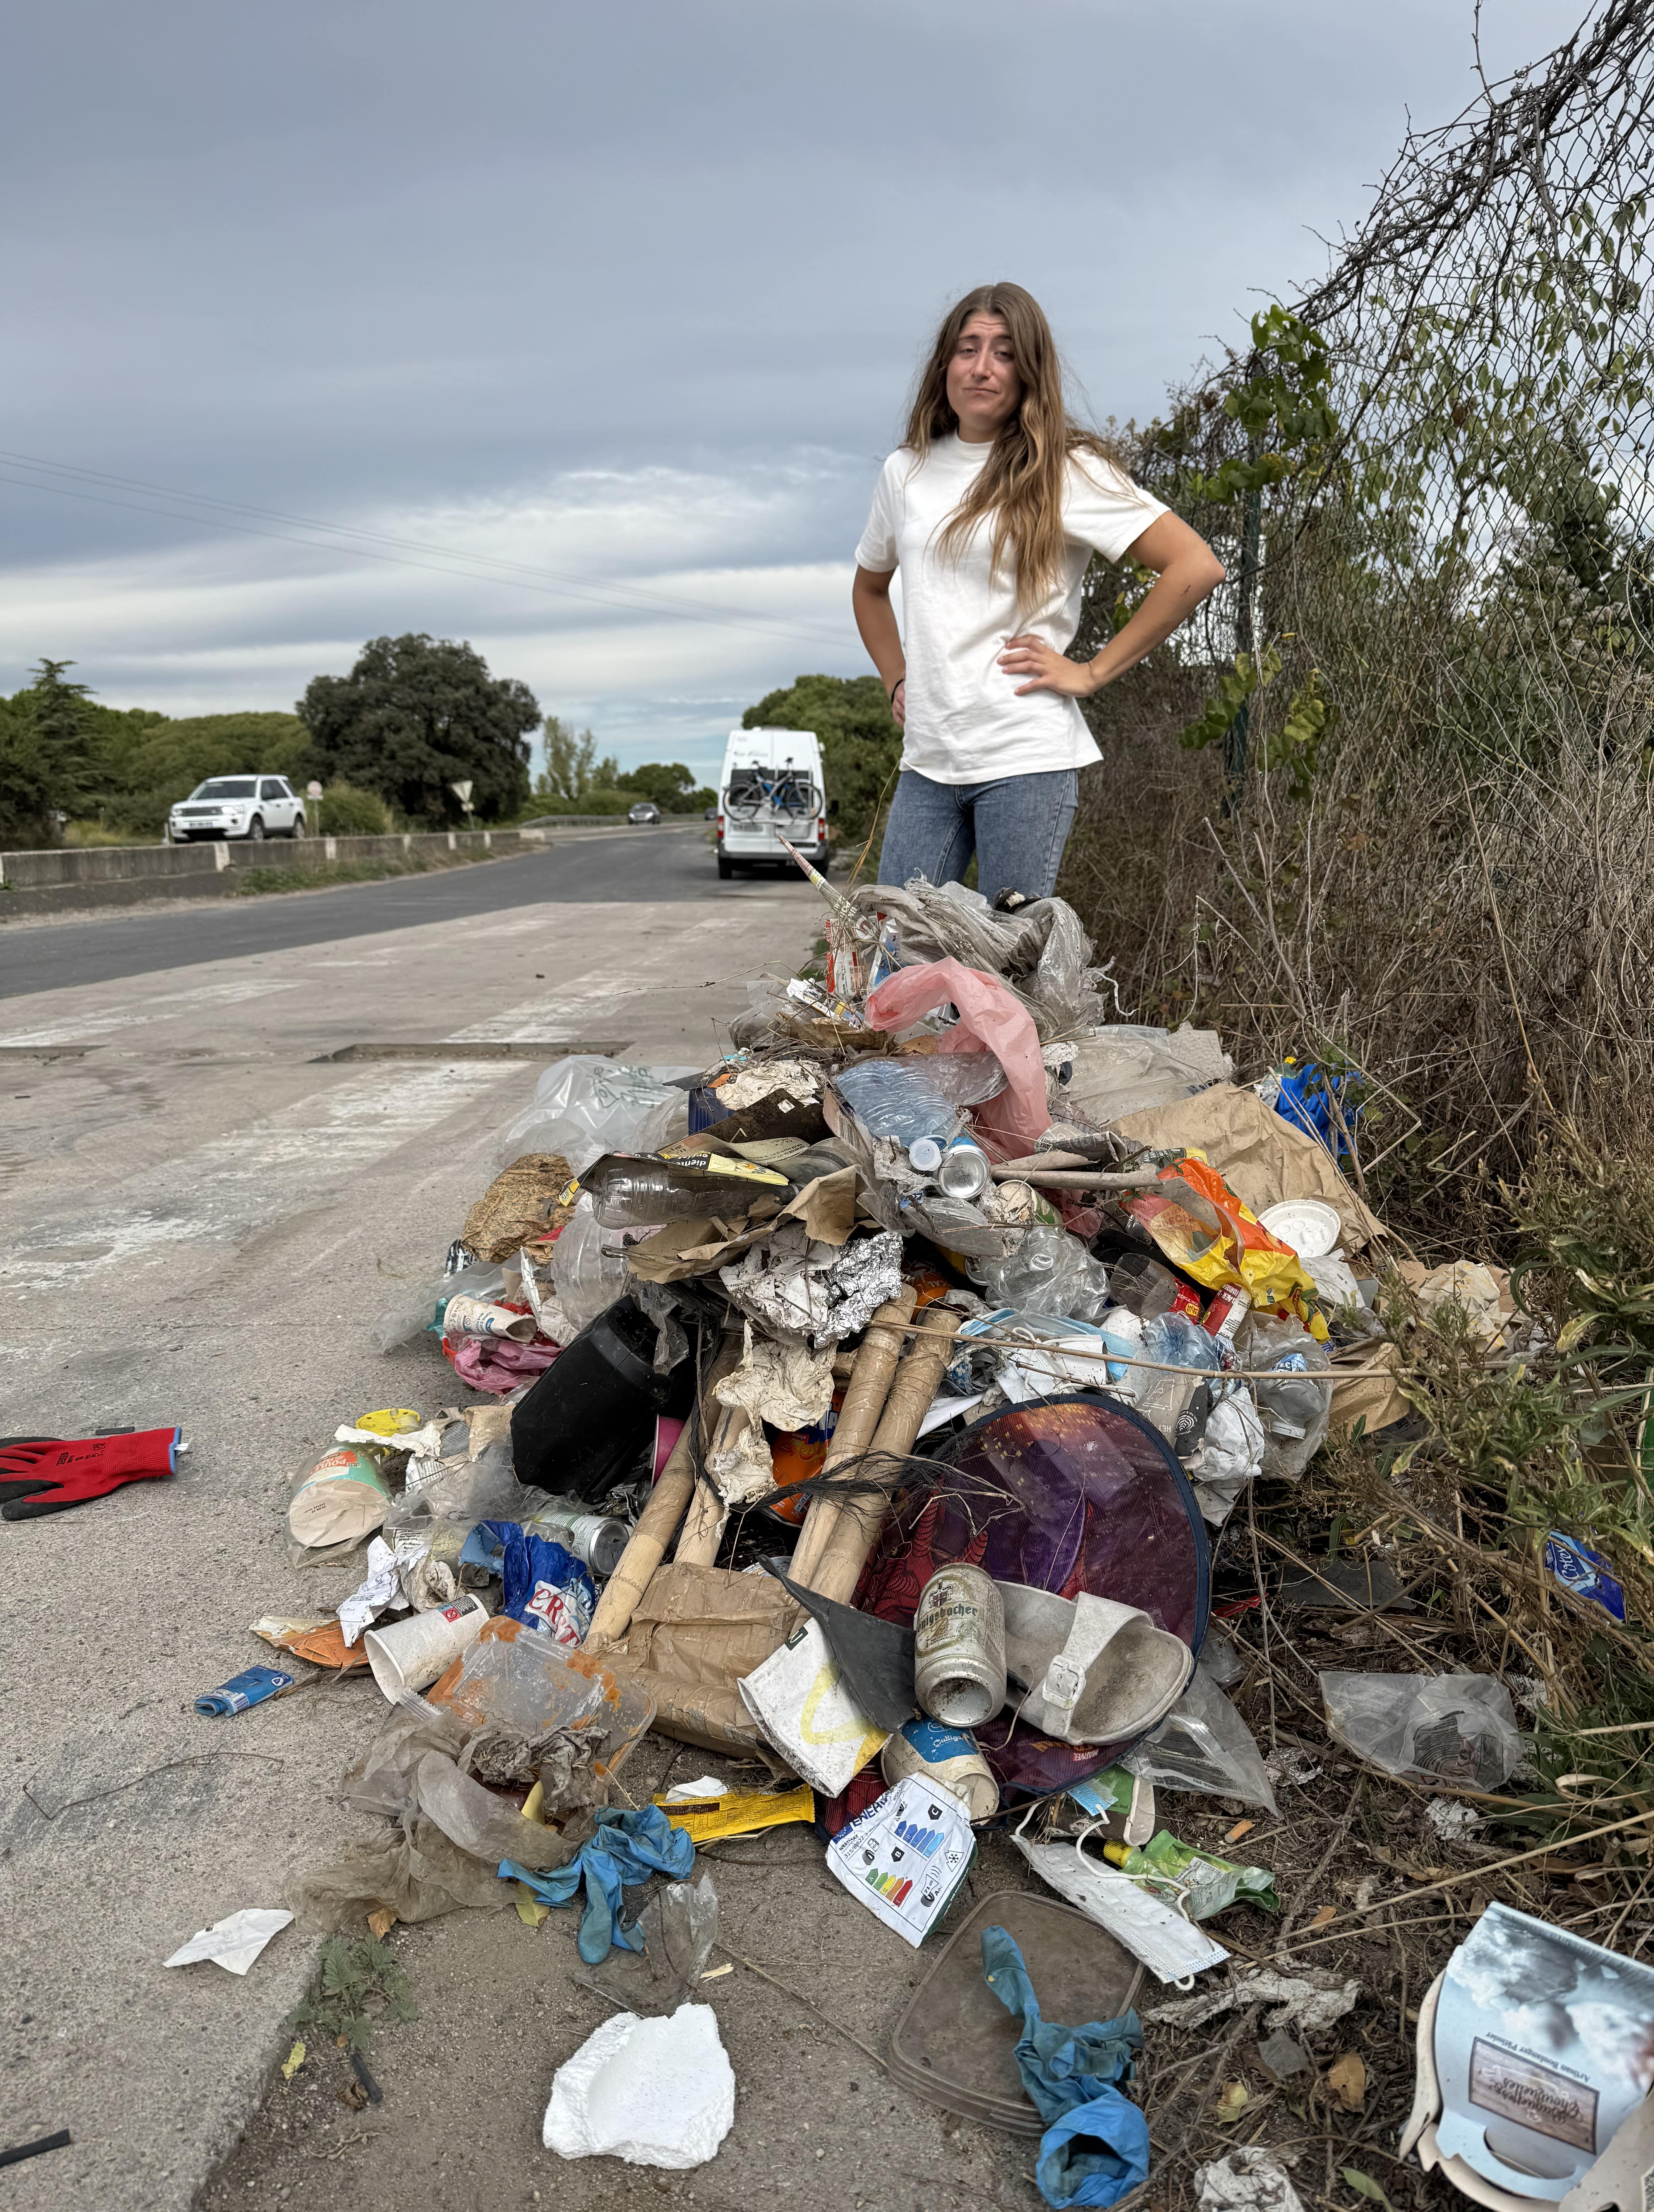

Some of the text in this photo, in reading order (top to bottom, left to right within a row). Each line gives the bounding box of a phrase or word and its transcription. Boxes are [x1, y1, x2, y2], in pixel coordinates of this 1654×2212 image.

[933, 1735, 963, 1747] Culliga
[1073, 1747, 1099, 1761] MARVEL
[839, 1834, 860, 1851] WESTLAKE
[1518, 2045, 1560, 2069] Boulanger
[1559, 2063, 1591, 2083] Artisan
